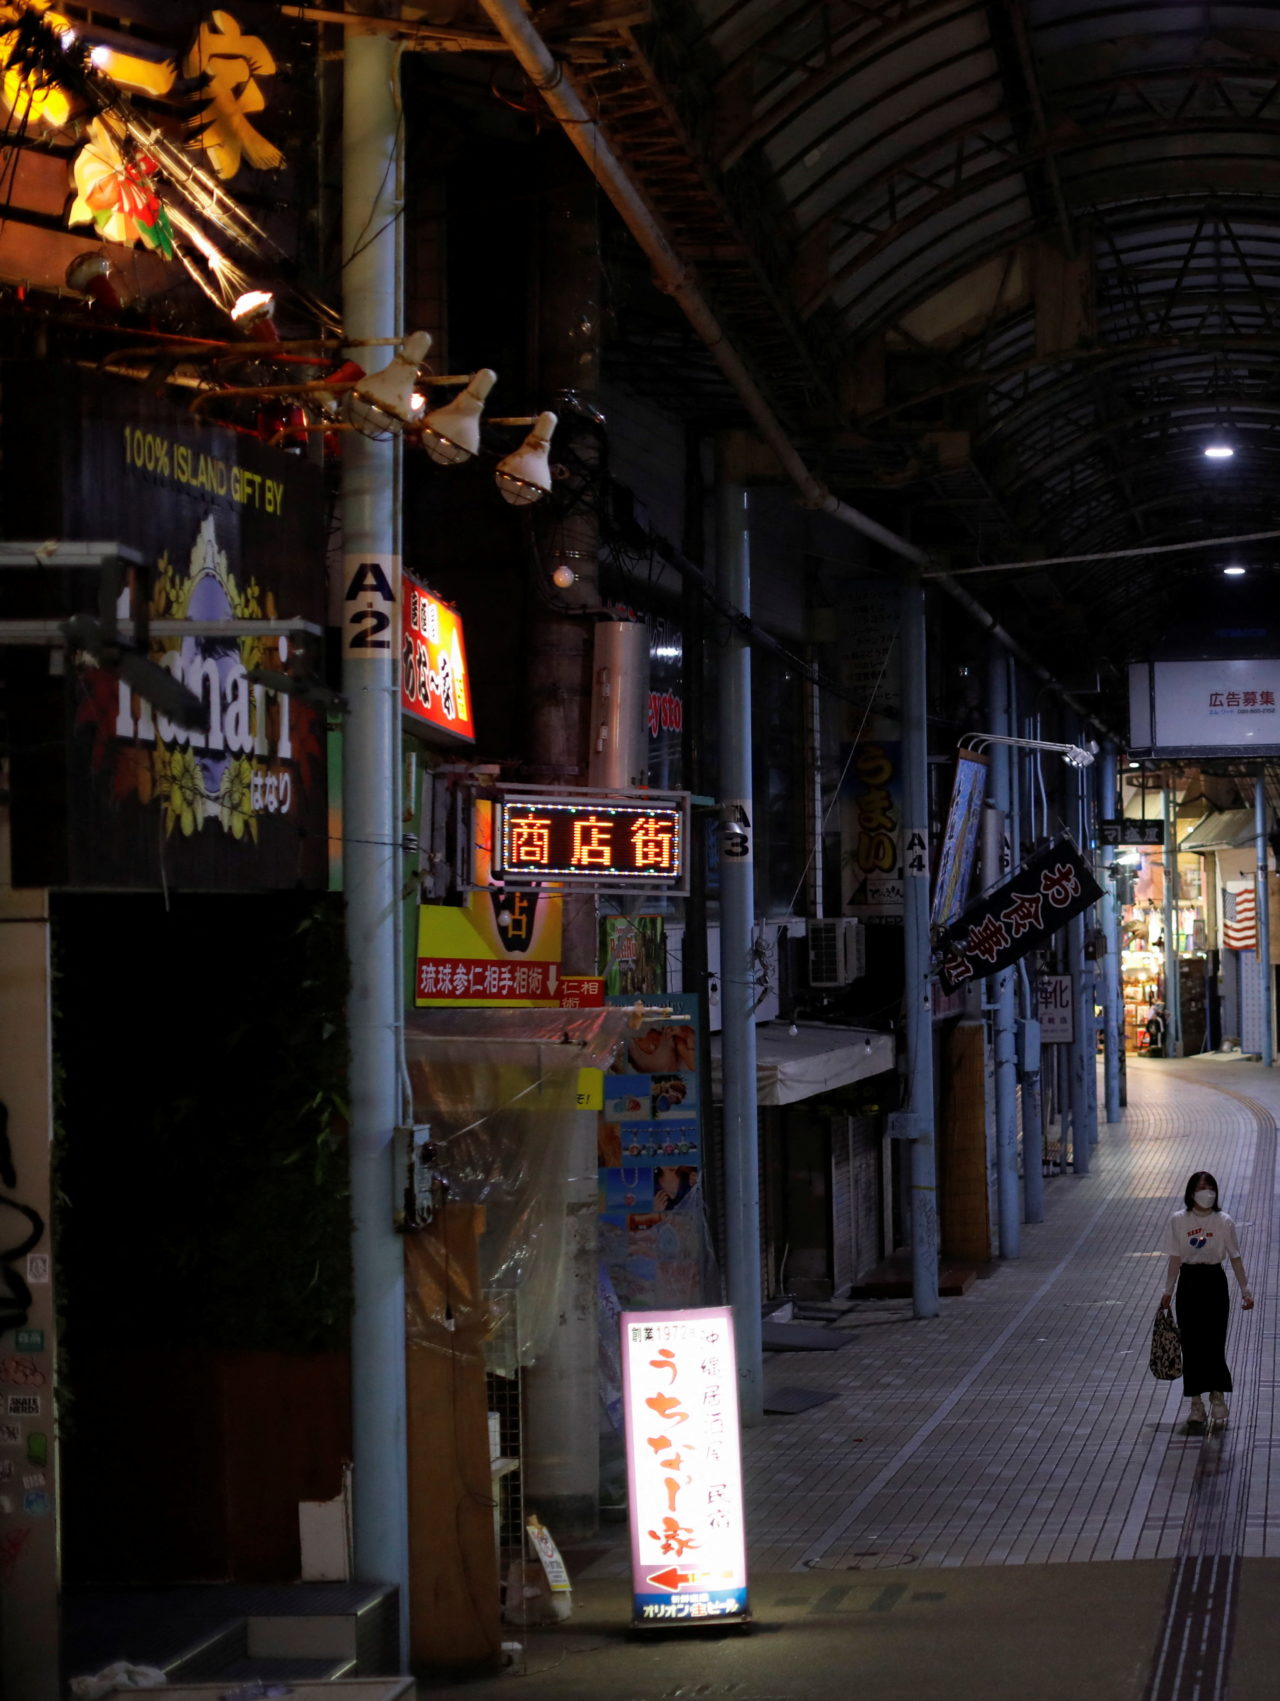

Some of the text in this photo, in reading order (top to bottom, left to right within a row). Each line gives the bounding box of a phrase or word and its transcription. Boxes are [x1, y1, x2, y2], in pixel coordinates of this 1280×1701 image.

[123, 425, 286, 516] 100% ISLAND GIFT BY
[1209, 690, 1275, 707] 広告募集
[251, 770, 292, 814] はなり
[509, 812, 673, 869] 商店街
[561, 980, 599, 995] 仁相
[642, 1598, 739, 1618] オリオン生ビール
